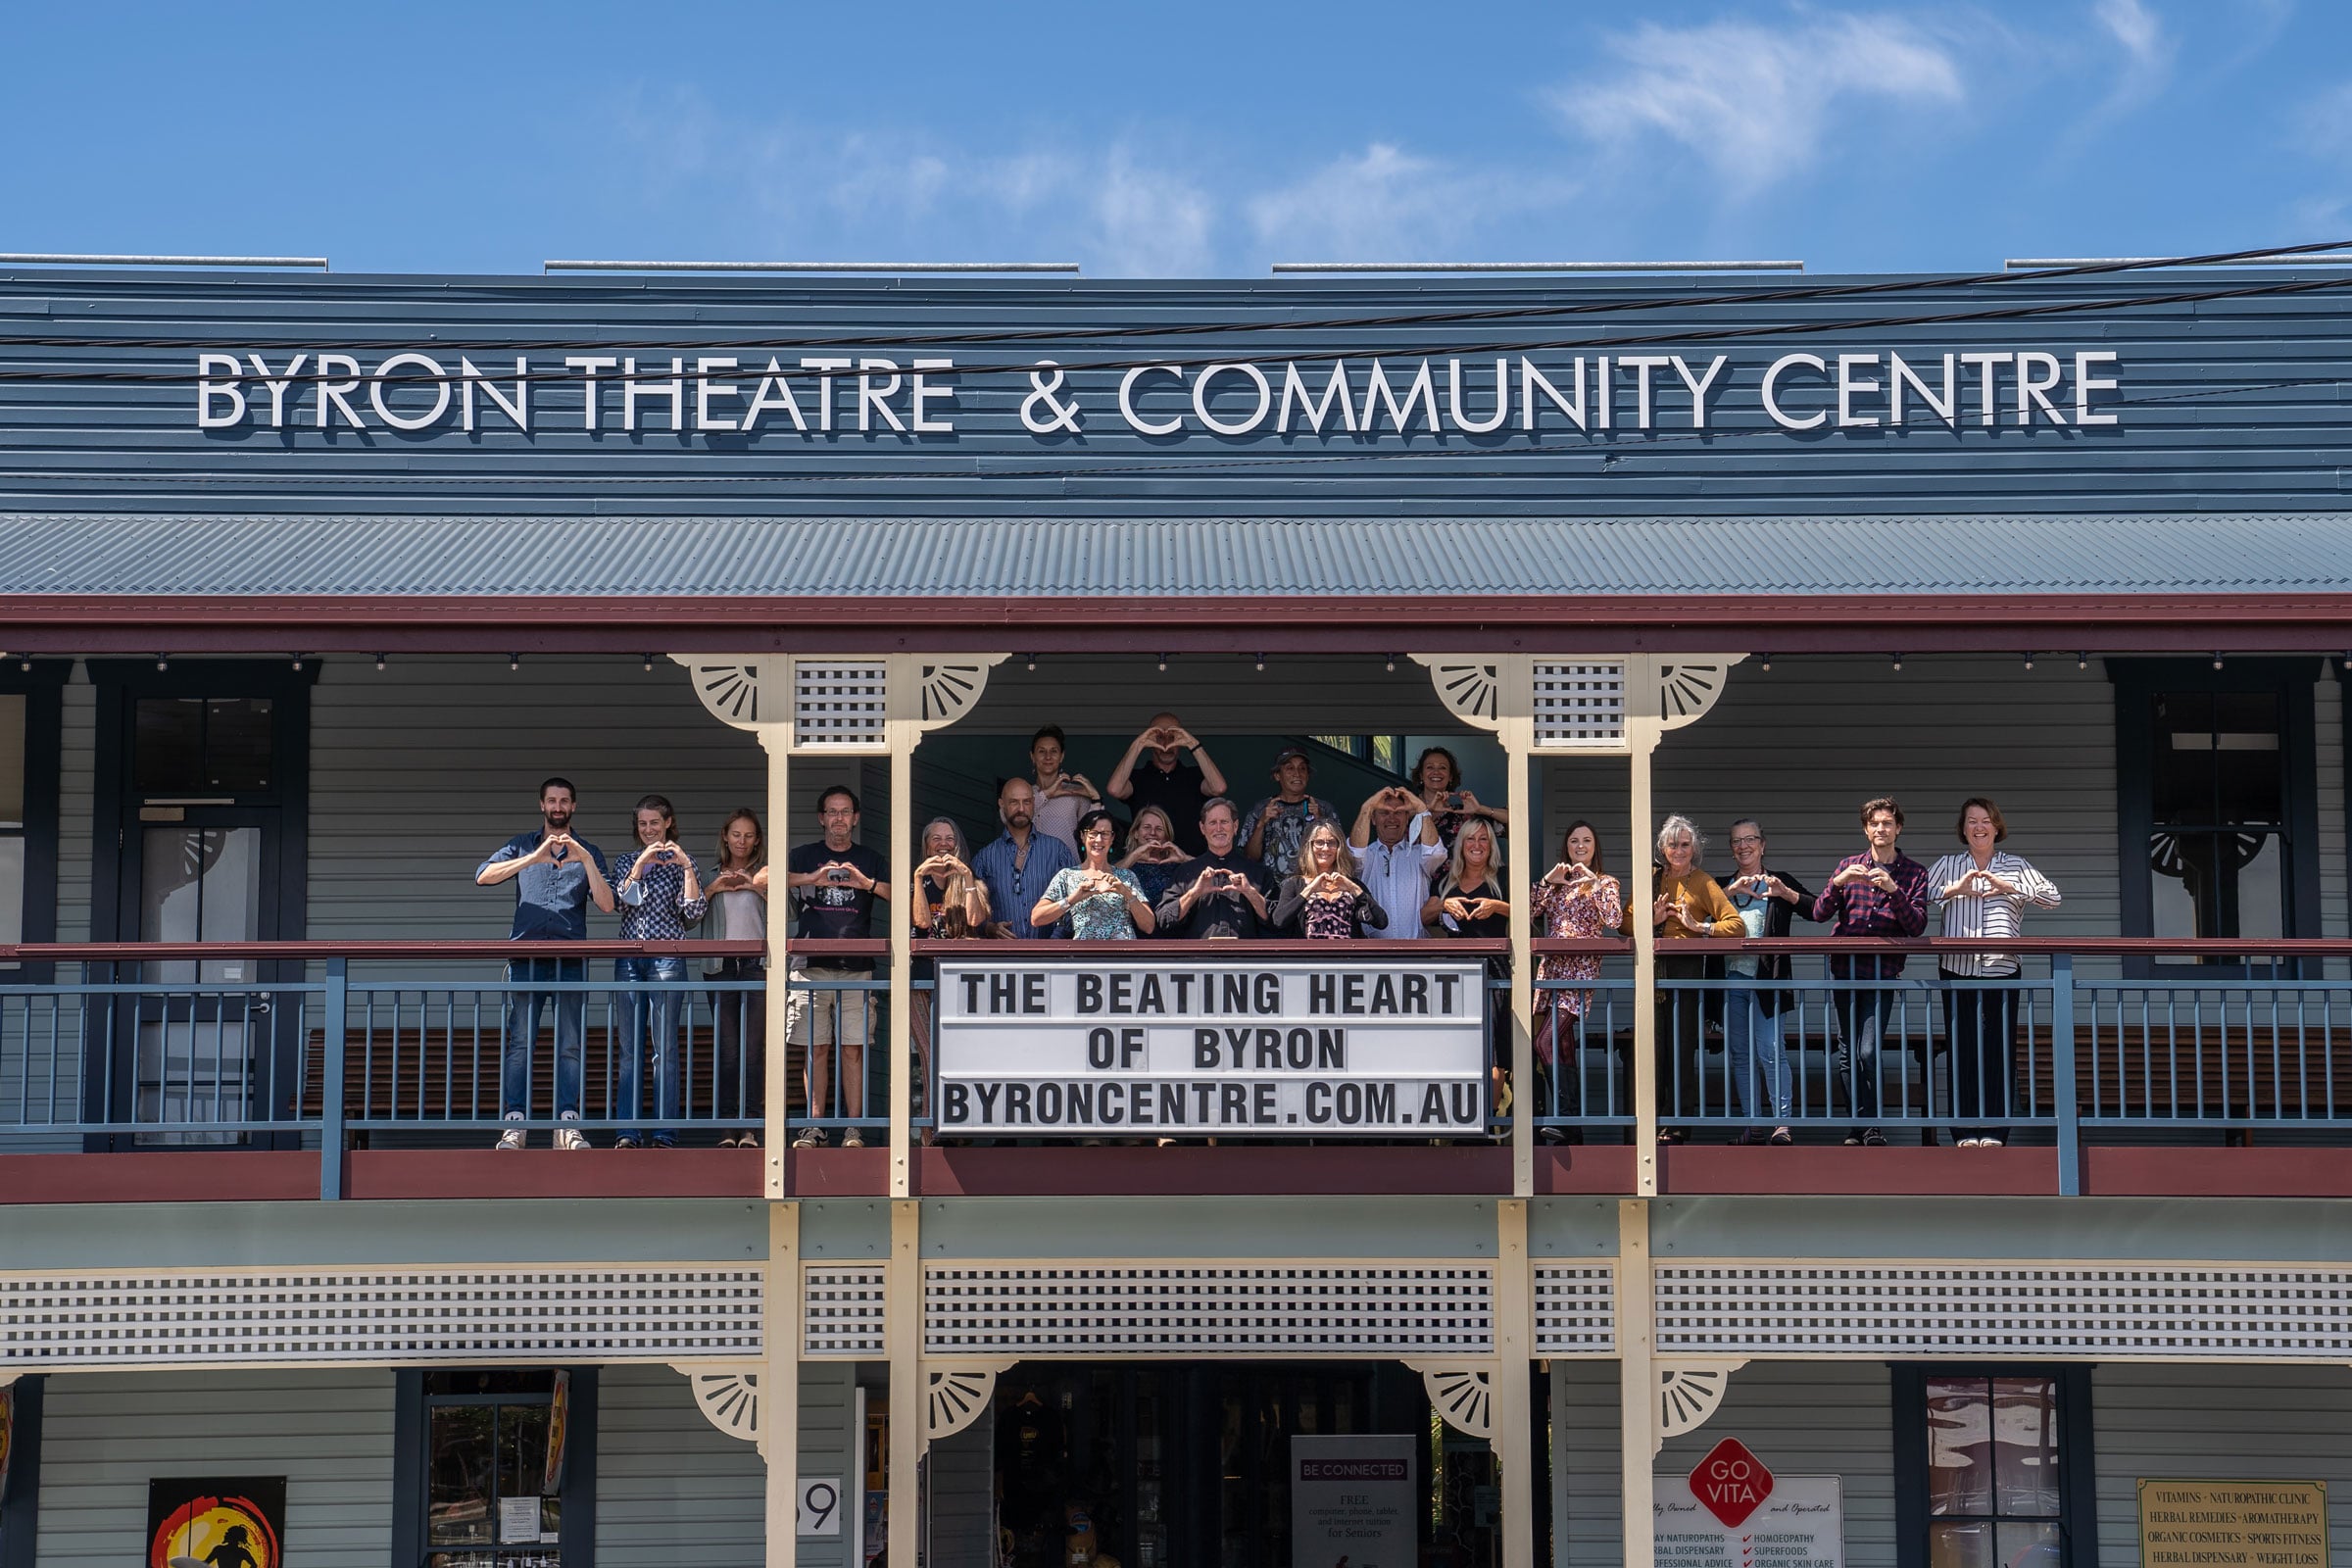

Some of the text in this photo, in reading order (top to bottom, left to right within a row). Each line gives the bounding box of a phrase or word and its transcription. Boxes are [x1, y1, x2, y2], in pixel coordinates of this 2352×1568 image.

[199, 352, 2117, 434] BYRON THEATRE & COMMUNITY CENTRE
[960, 972, 1459, 1014] THE BEATING HEART
[1089, 1027, 1344, 1069] OF BYRON
[944, 1082, 1478, 1125] BYRONCENTRE.COM.AU
[1303, 1464, 1404, 1476] BE CONNECTED
[1711, 1460, 1750, 1480] GO
[1341, 1495, 1369, 1505] FREE
[1706, 1484, 1756, 1503] VITA
[2156, 1492, 2311, 1505] VITAMINS NATUROPATHIC CLINIC
[797, 1484, 837, 1530] 9
[1791, 1503, 1831, 1515] Operated
[2150, 1511, 2319, 1524] HERBAL REMEDIES AROMATHERAPY
[1328, 1528, 1382, 1538] for Seniors
[1667, 1534, 1725, 1543] NATUROPATHS
[2148, 1531, 2321, 1545] ORGANIC COSMETICS SPORTS FITNESS
[1754, 1546, 1807, 1555] SUPERFOODS
[1705, 1559, 1733, 1568] ADVICE
[2153, 1551, 2319, 1564] HERBAL DISPENSARY WEIGHT LOSS
